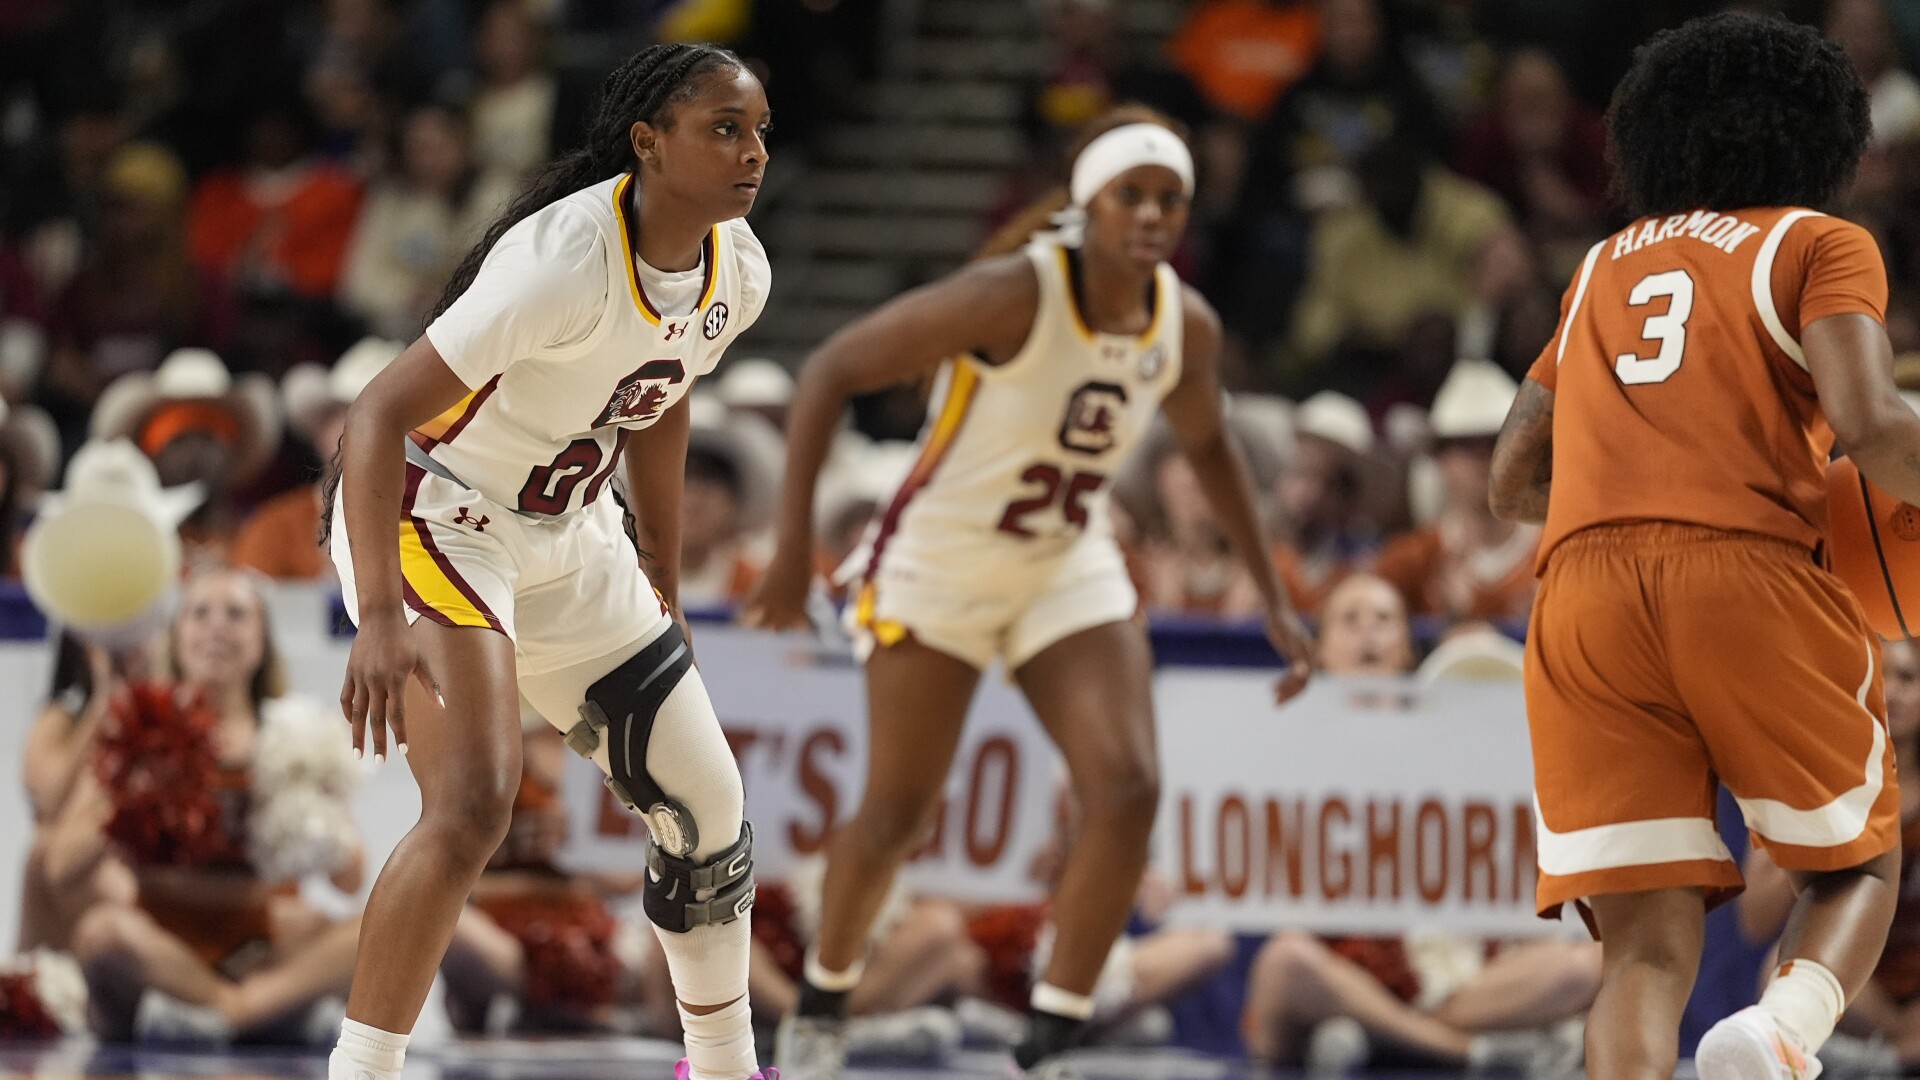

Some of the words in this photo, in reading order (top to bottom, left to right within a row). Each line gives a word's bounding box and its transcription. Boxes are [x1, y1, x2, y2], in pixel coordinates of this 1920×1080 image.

[1611, 210, 1761, 261] HARMON
[704, 304, 727, 338] SEC
[1614, 268, 1695, 385] 3
[998, 462, 1107, 539] 25
